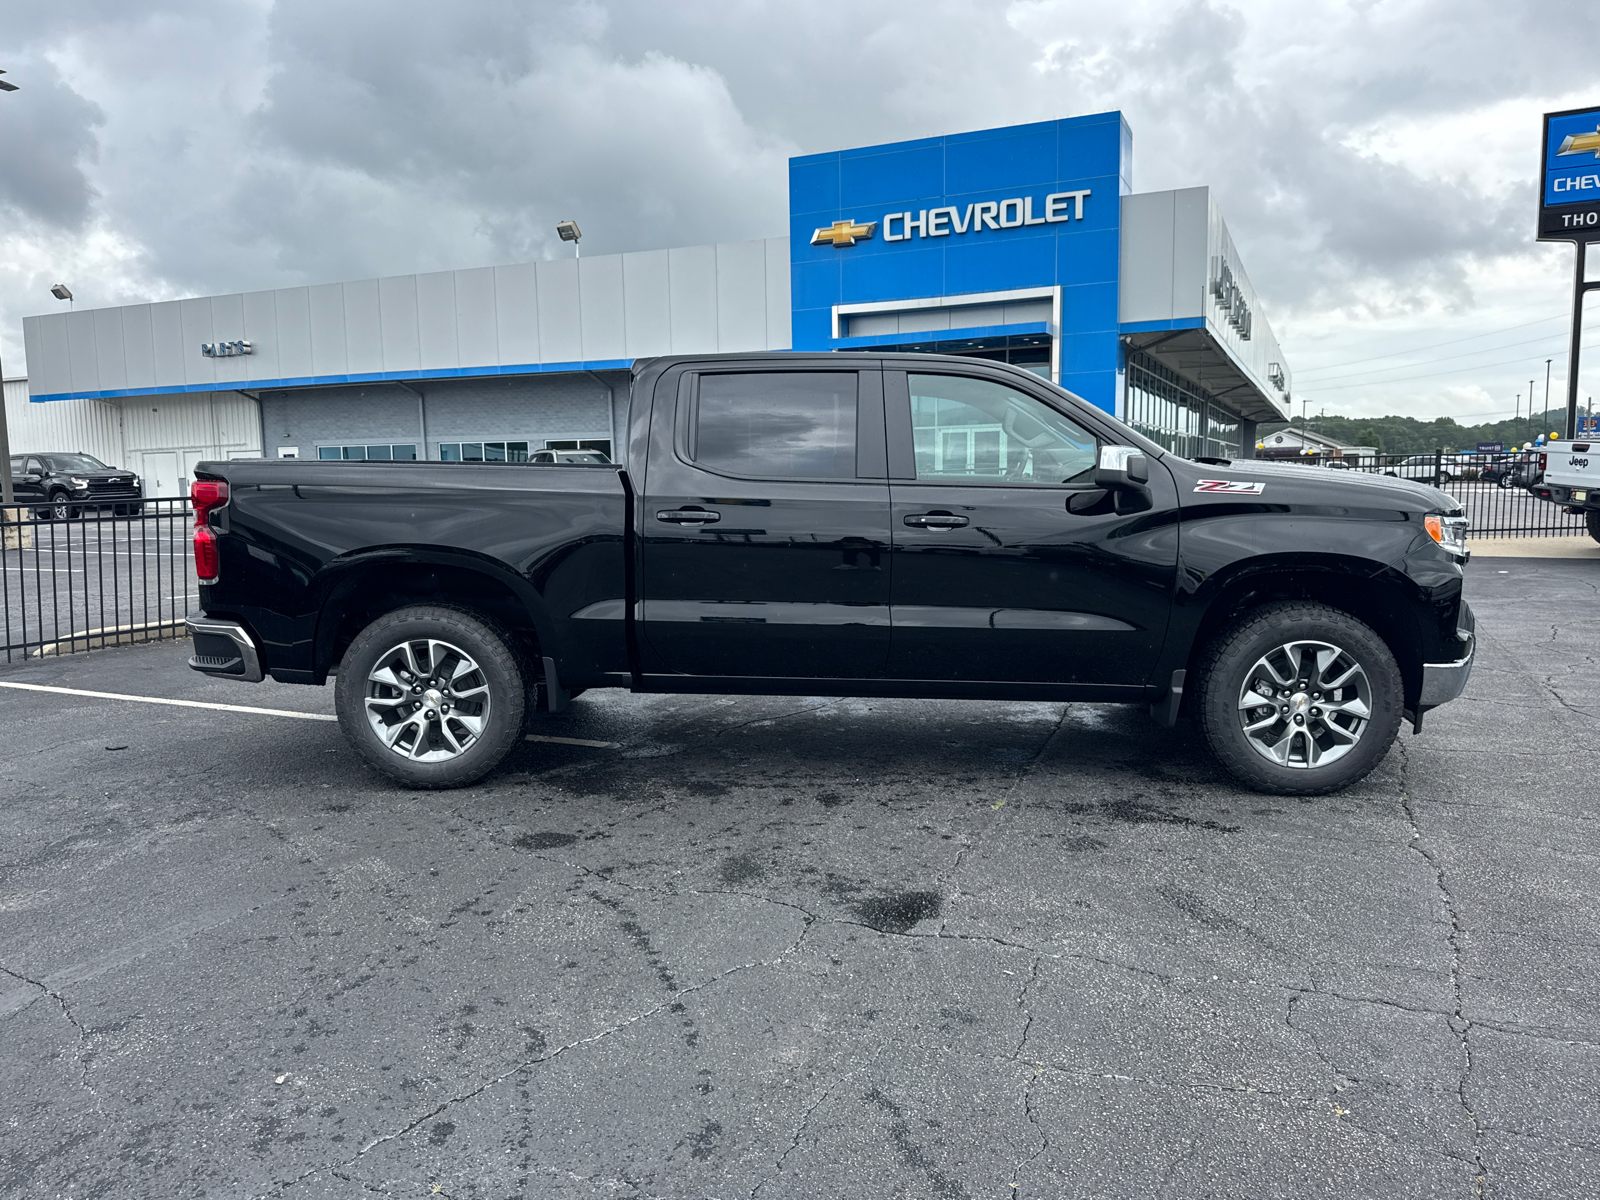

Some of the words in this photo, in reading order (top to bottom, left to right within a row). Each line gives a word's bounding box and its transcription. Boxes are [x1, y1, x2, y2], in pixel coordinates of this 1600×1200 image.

[883, 189, 1091, 241] CHEVROLET
[1562, 212, 1598, 227] THO
[201, 340, 248, 357] PARTS
[1569, 455, 1589, 469] Jeep
[1193, 479, 1266, 495] Z71
